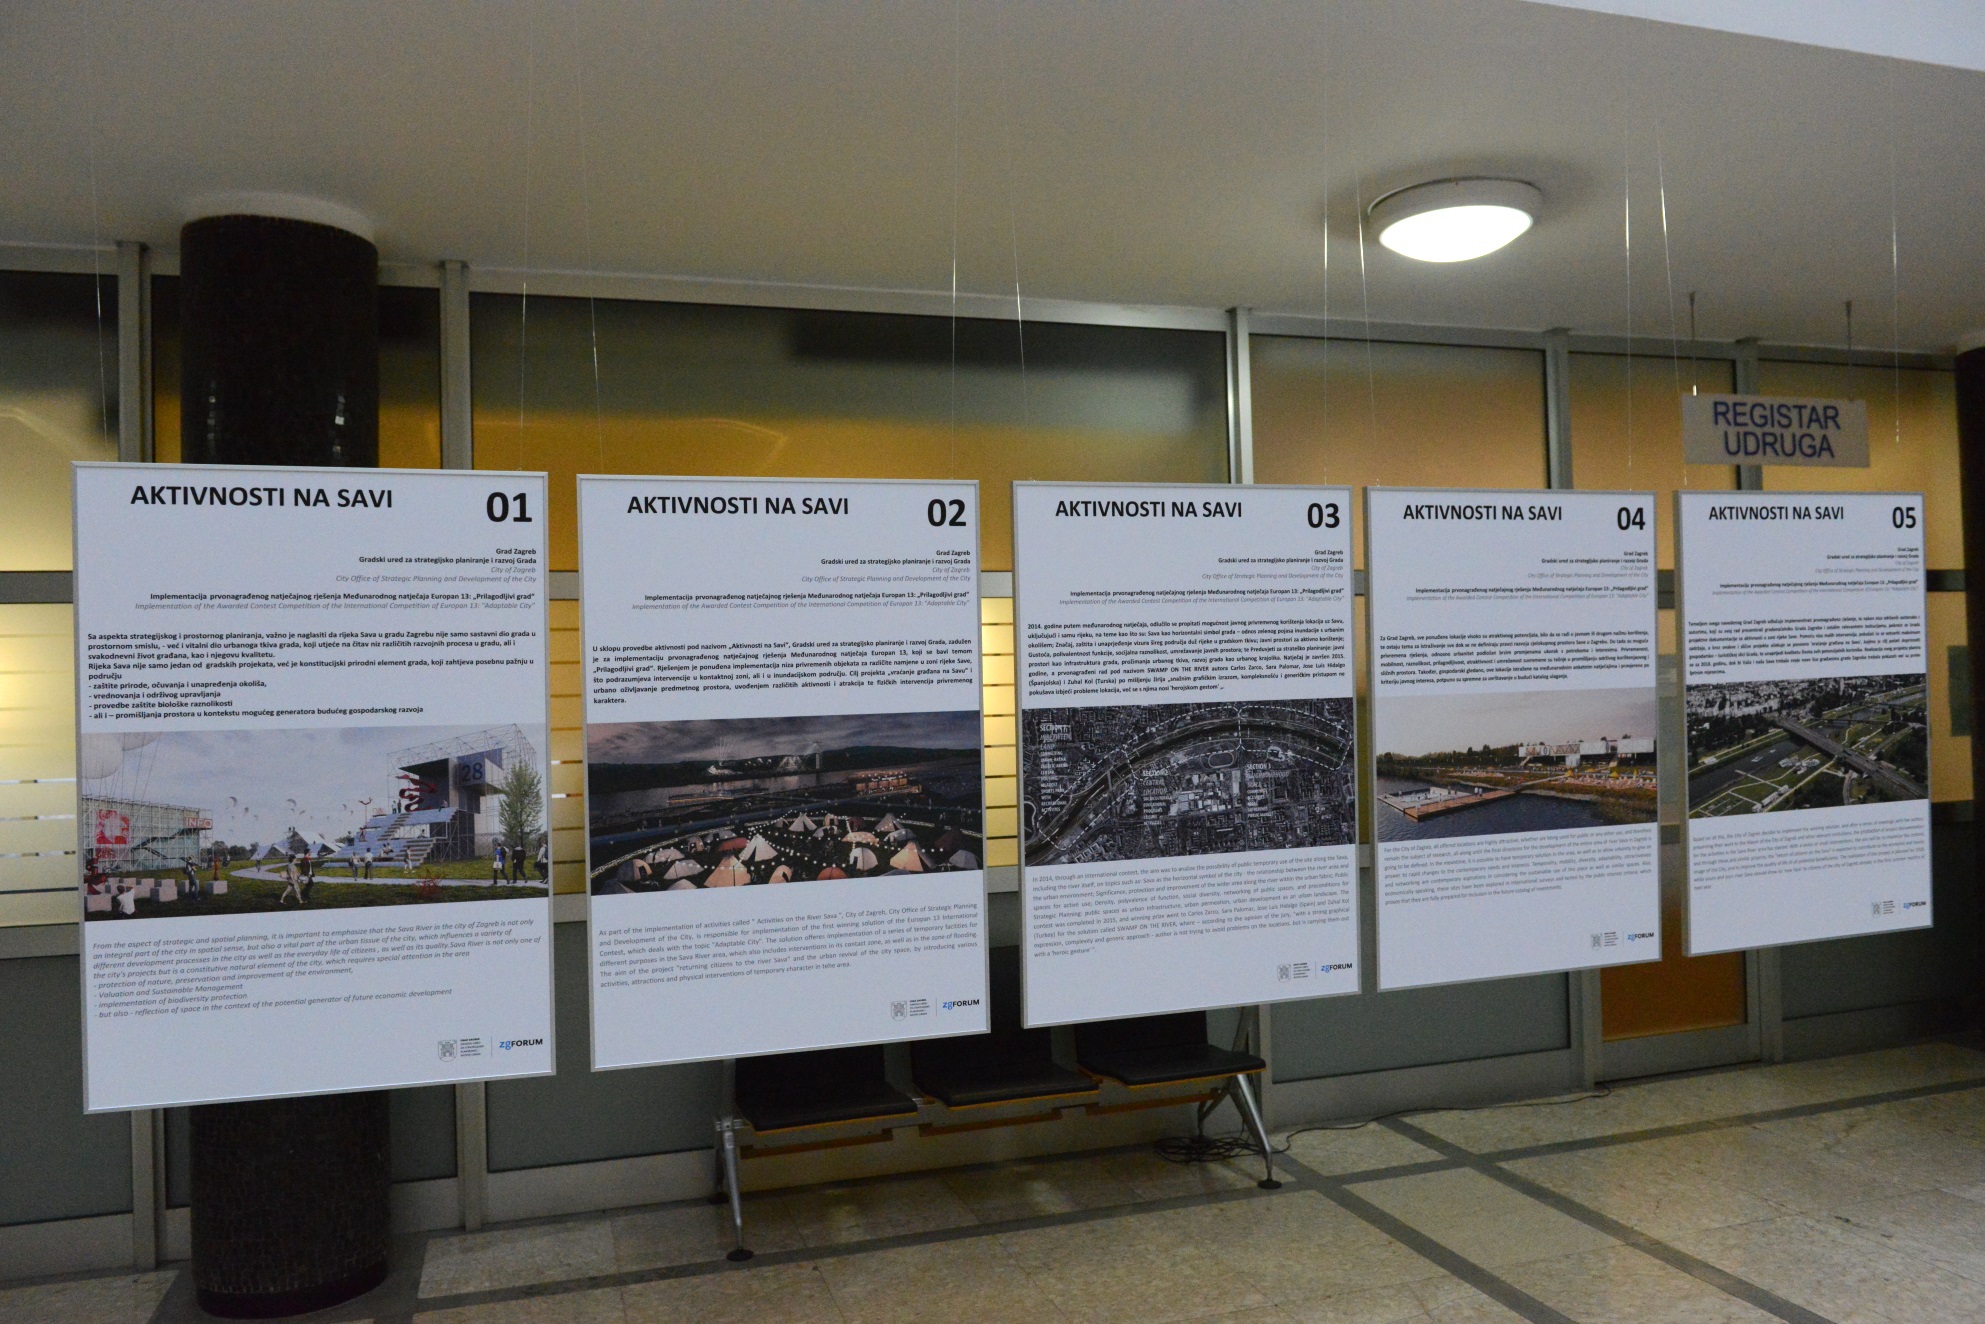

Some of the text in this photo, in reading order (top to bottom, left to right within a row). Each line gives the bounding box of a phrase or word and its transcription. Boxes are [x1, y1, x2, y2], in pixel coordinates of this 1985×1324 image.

[1713, 401, 1841, 431] REGISTAR
[1724, 430, 1836, 459] UDRUGA
[130, 485, 392, 508] AKTIVNOSTI NA SAVI
[627, 496, 848, 515] AKTIVNOSTI NA SAVI
[486, 491, 533, 523] 01
[927, 498, 967, 527] 02
[1055, 500, 1242, 518] AKTIVNOSTI NA SAVI
[1307, 502, 1340, 529] 03
[1403, 504, 1562, 521] AKTIVNOSTI NA SAVI
[1708, 506, 1844, 520] AKTIVNOSTI NA SAVI
[1617, 506, 1646, 531] 04
[1892, 506, 1916, 529] 05
[414, 556, 454, 564] strategijsko
[455, 556, 490, 565] planiranje
[335, 574, 350, 582] City
[350, 574, 372, 583] Office
[372, 574, 381, 583] of
[380, 575, 412, 583] Strategic
[412, 575, 443, 584] Planning
[503, 575, 511, 584] of
[523, 575, 537, 583] City
[150, 593, 208, 601] Implementacija
[209, 592, 269, 601] prvonagrađenog
[270, 592, 312, 601] natječajnog
[313, 593, 342, 601] rješenja
[342, 592, 397, 601] Međunarodnog
[398, 593, 430, 601] natječaja
[98, 633, 128, 641] aspekta
[129, 632, 178, 641] strategijskog
[288, 632, 296, 640] je
[296, 631, 327, 640] naglasiti
[338, 631, 359, 639] rijeka
[406, 631, 434, 639] Zagrebu
[510, 630, 530, 638] grada
[93, 701, 130, 710] provedbe
[461, 762, 484, 782] 28
[185, 818, 213, 828] INFO
[135, 988, 151, 996] and
[151, 986, 194, 995] Sustainable
[194, 983, 243, 993] Management
[499, 1038, 543, 1051] zgFORUM
